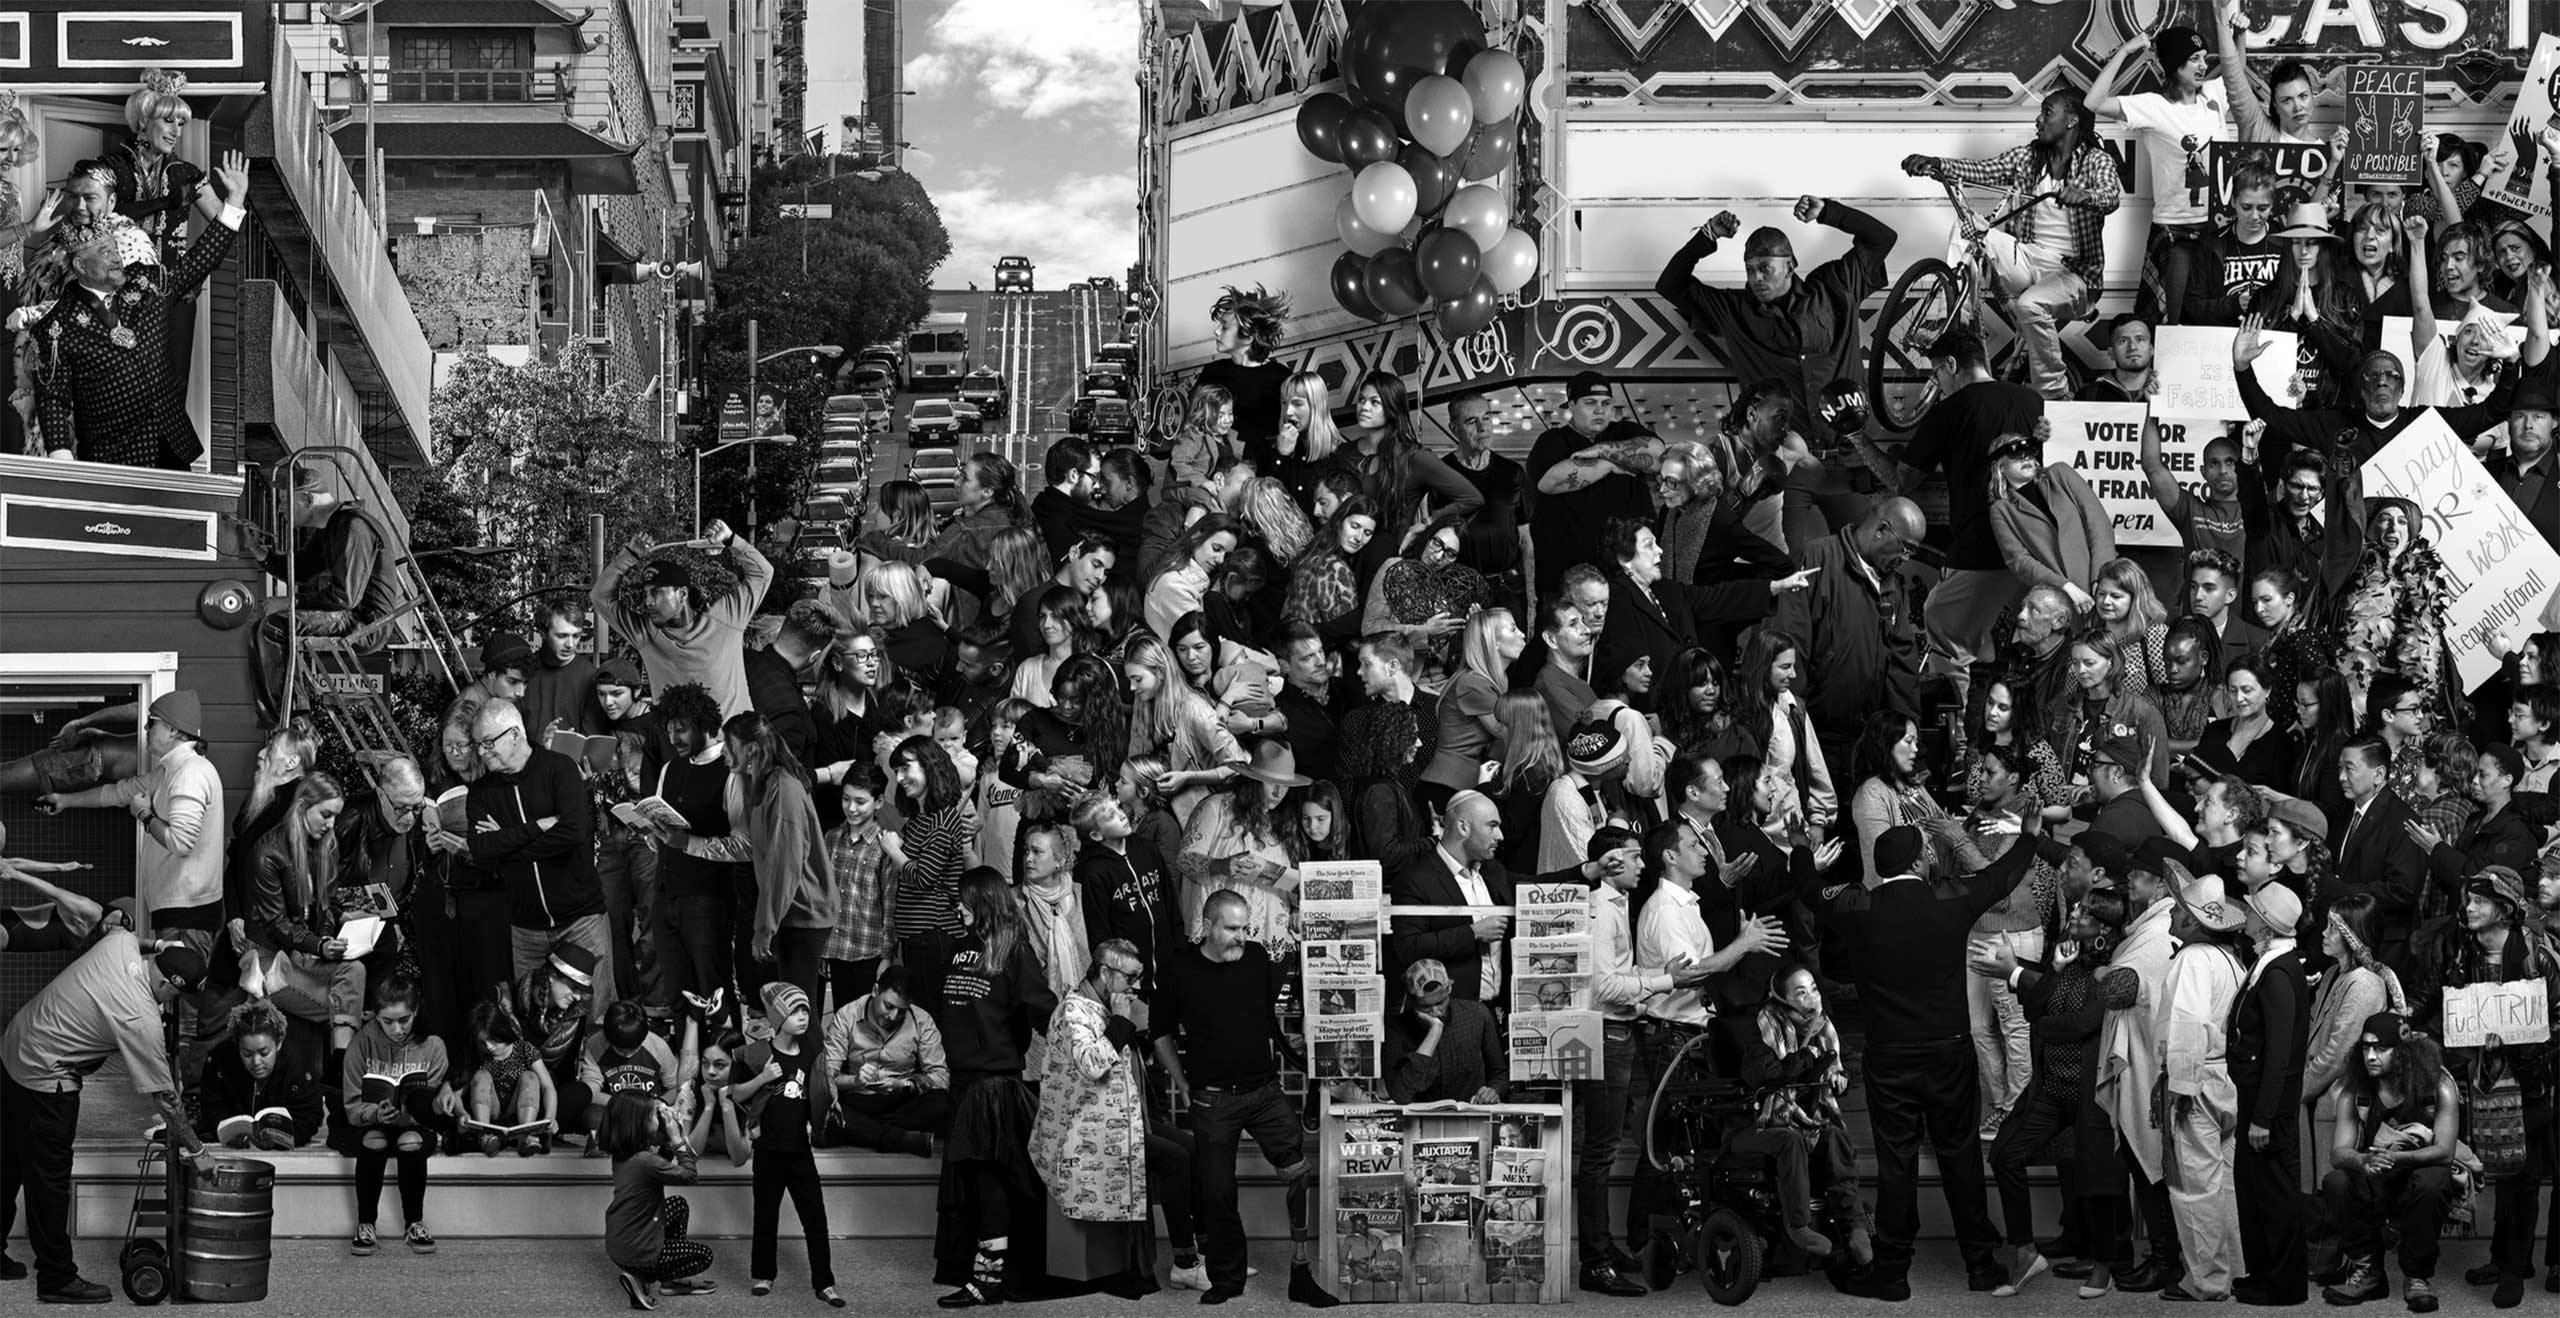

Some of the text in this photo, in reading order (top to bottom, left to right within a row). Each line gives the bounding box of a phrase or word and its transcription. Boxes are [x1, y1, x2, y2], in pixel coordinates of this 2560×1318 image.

[2353, 69, 2420, 94] PEACE
[2216, 147, 2328, 206] WLD
[2084, 422, 2187, 443] VOTE OR
[2073, 450, 2196, 472] A FUR-REE
[2404, 432, 2464, 511] pay
[2098, 479, 2212, 503] FRANSCO
[2421, 491, 2474, 549] OR
[1303, 911, 1331, 919] EPOCH
[952, 950, 982, 965] NTY
[1347, 1033, 1374, 1041] change
[1520, 1047, 1545, 1055] HOMELESS
[1340, 1143, 1401, 1157] WIRE
[1418, 1145, 1473, 1156] JUXTAPOZ
[1507, 1165, 1529, 1174] THE
[1502, 1173, 1532, 1183] NEXT
[1422, 1194, 1468, 1205] Foes
